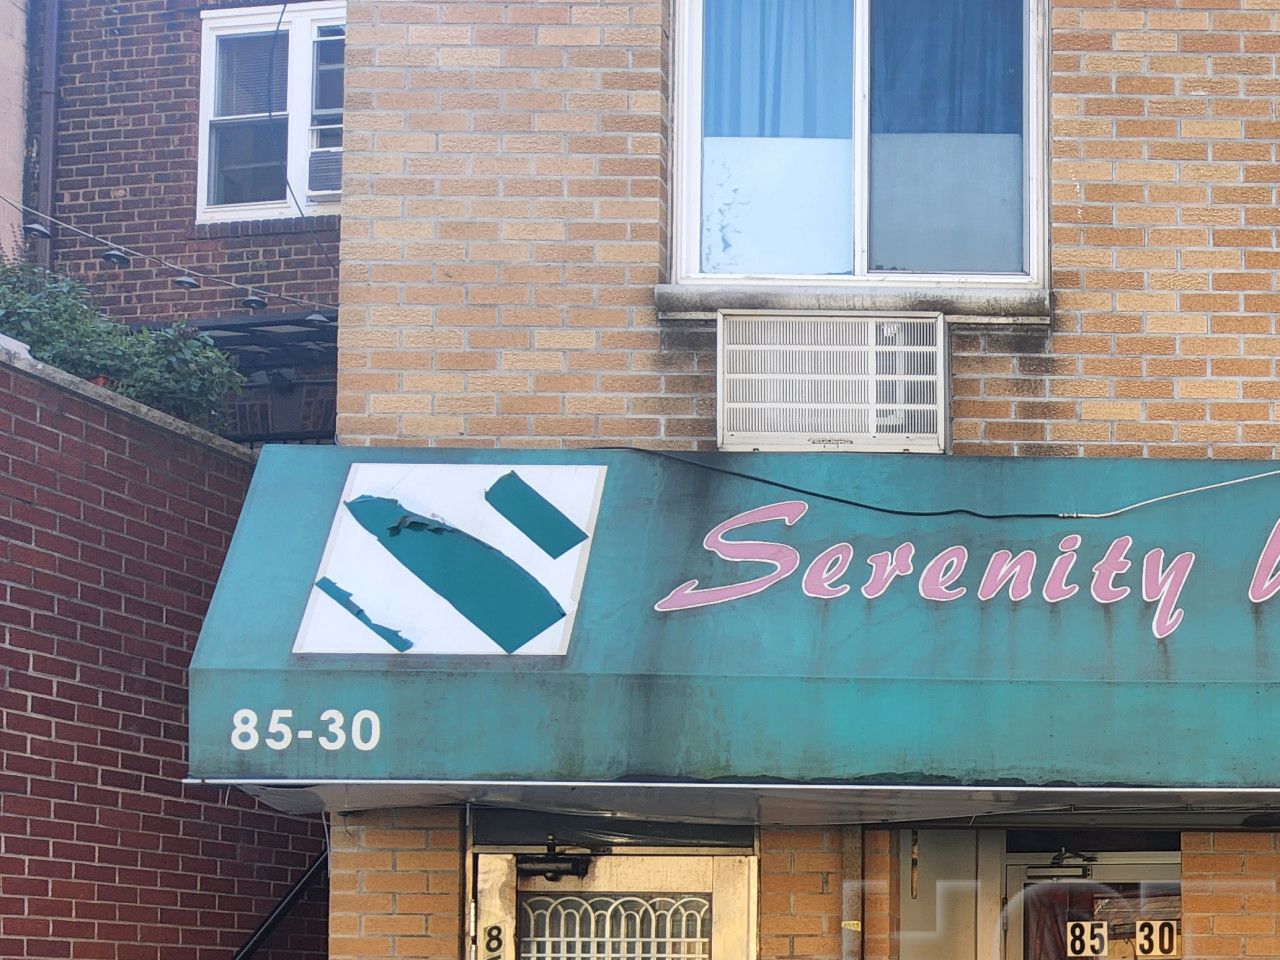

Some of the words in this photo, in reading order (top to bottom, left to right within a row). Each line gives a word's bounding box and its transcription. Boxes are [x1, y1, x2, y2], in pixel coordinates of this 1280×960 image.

[654, 500, 1196, 638] Serenity
[230, 708, 382, 751] 85-30
[1070, 922, 1106, 955] 85
[1139, 922, 1175, 954] 30
